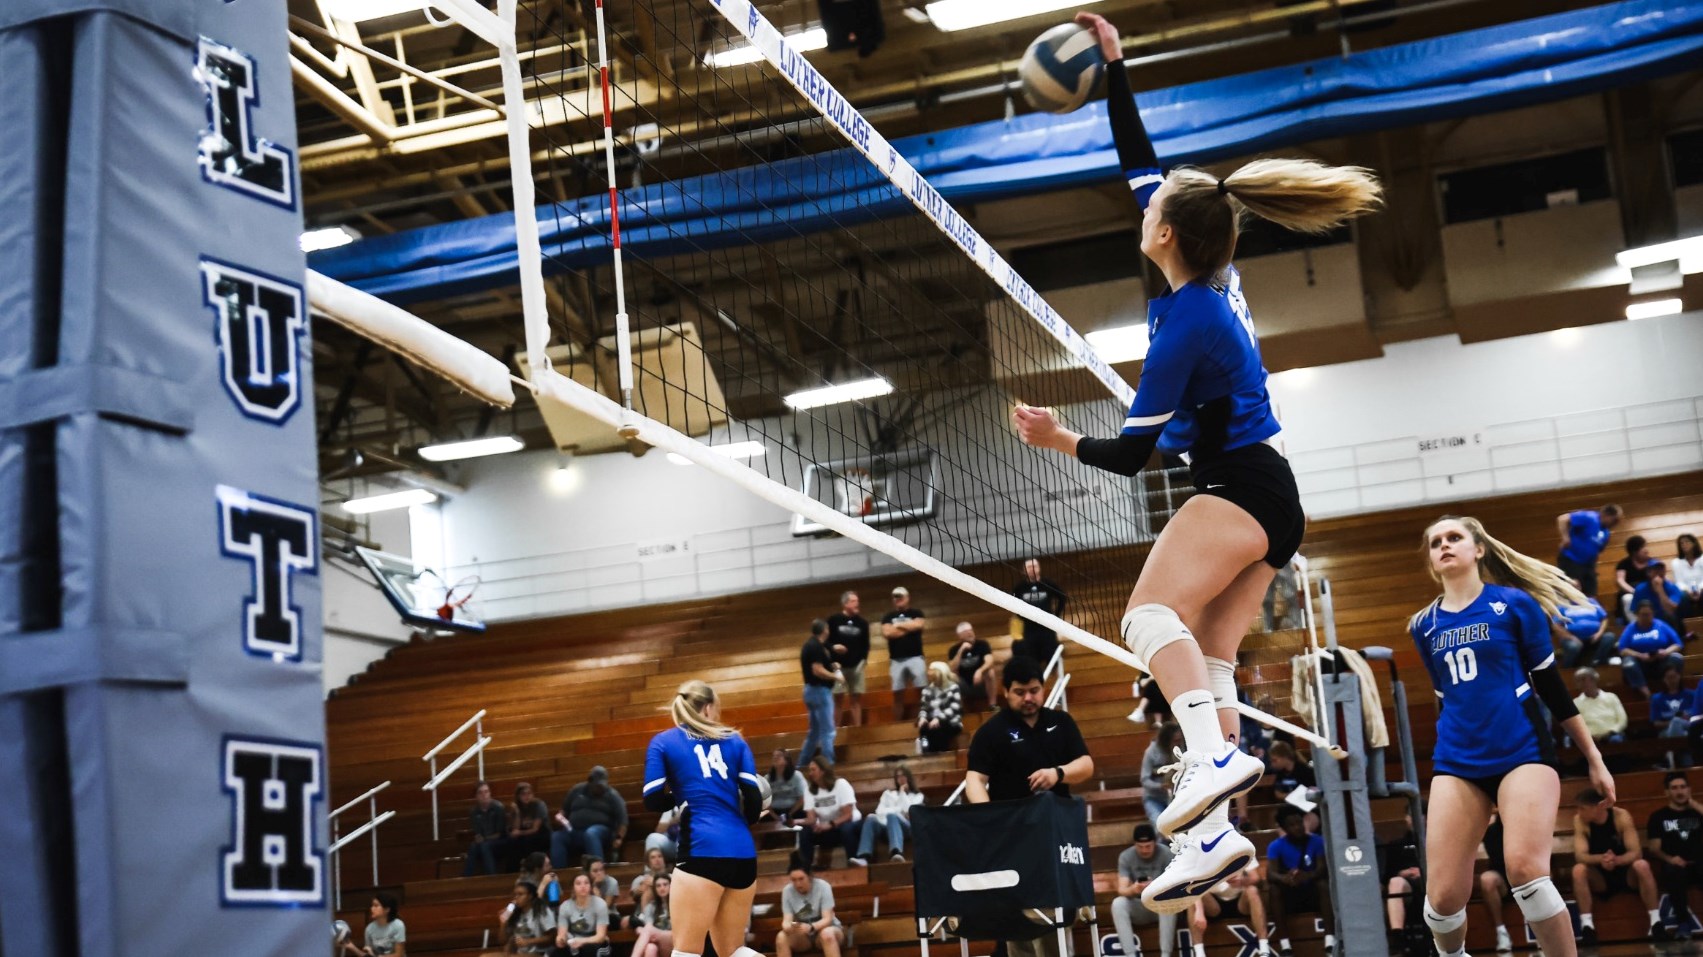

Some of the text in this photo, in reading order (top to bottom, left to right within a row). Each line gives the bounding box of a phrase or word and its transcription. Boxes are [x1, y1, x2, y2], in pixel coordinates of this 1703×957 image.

[779, 39, 871, 152] LUTHER COLLEGE
[1432, 622, 1490, 655] LUTHER
[1443, 647, 1478, 685] 10
[693, 743, 729, 780] 14
